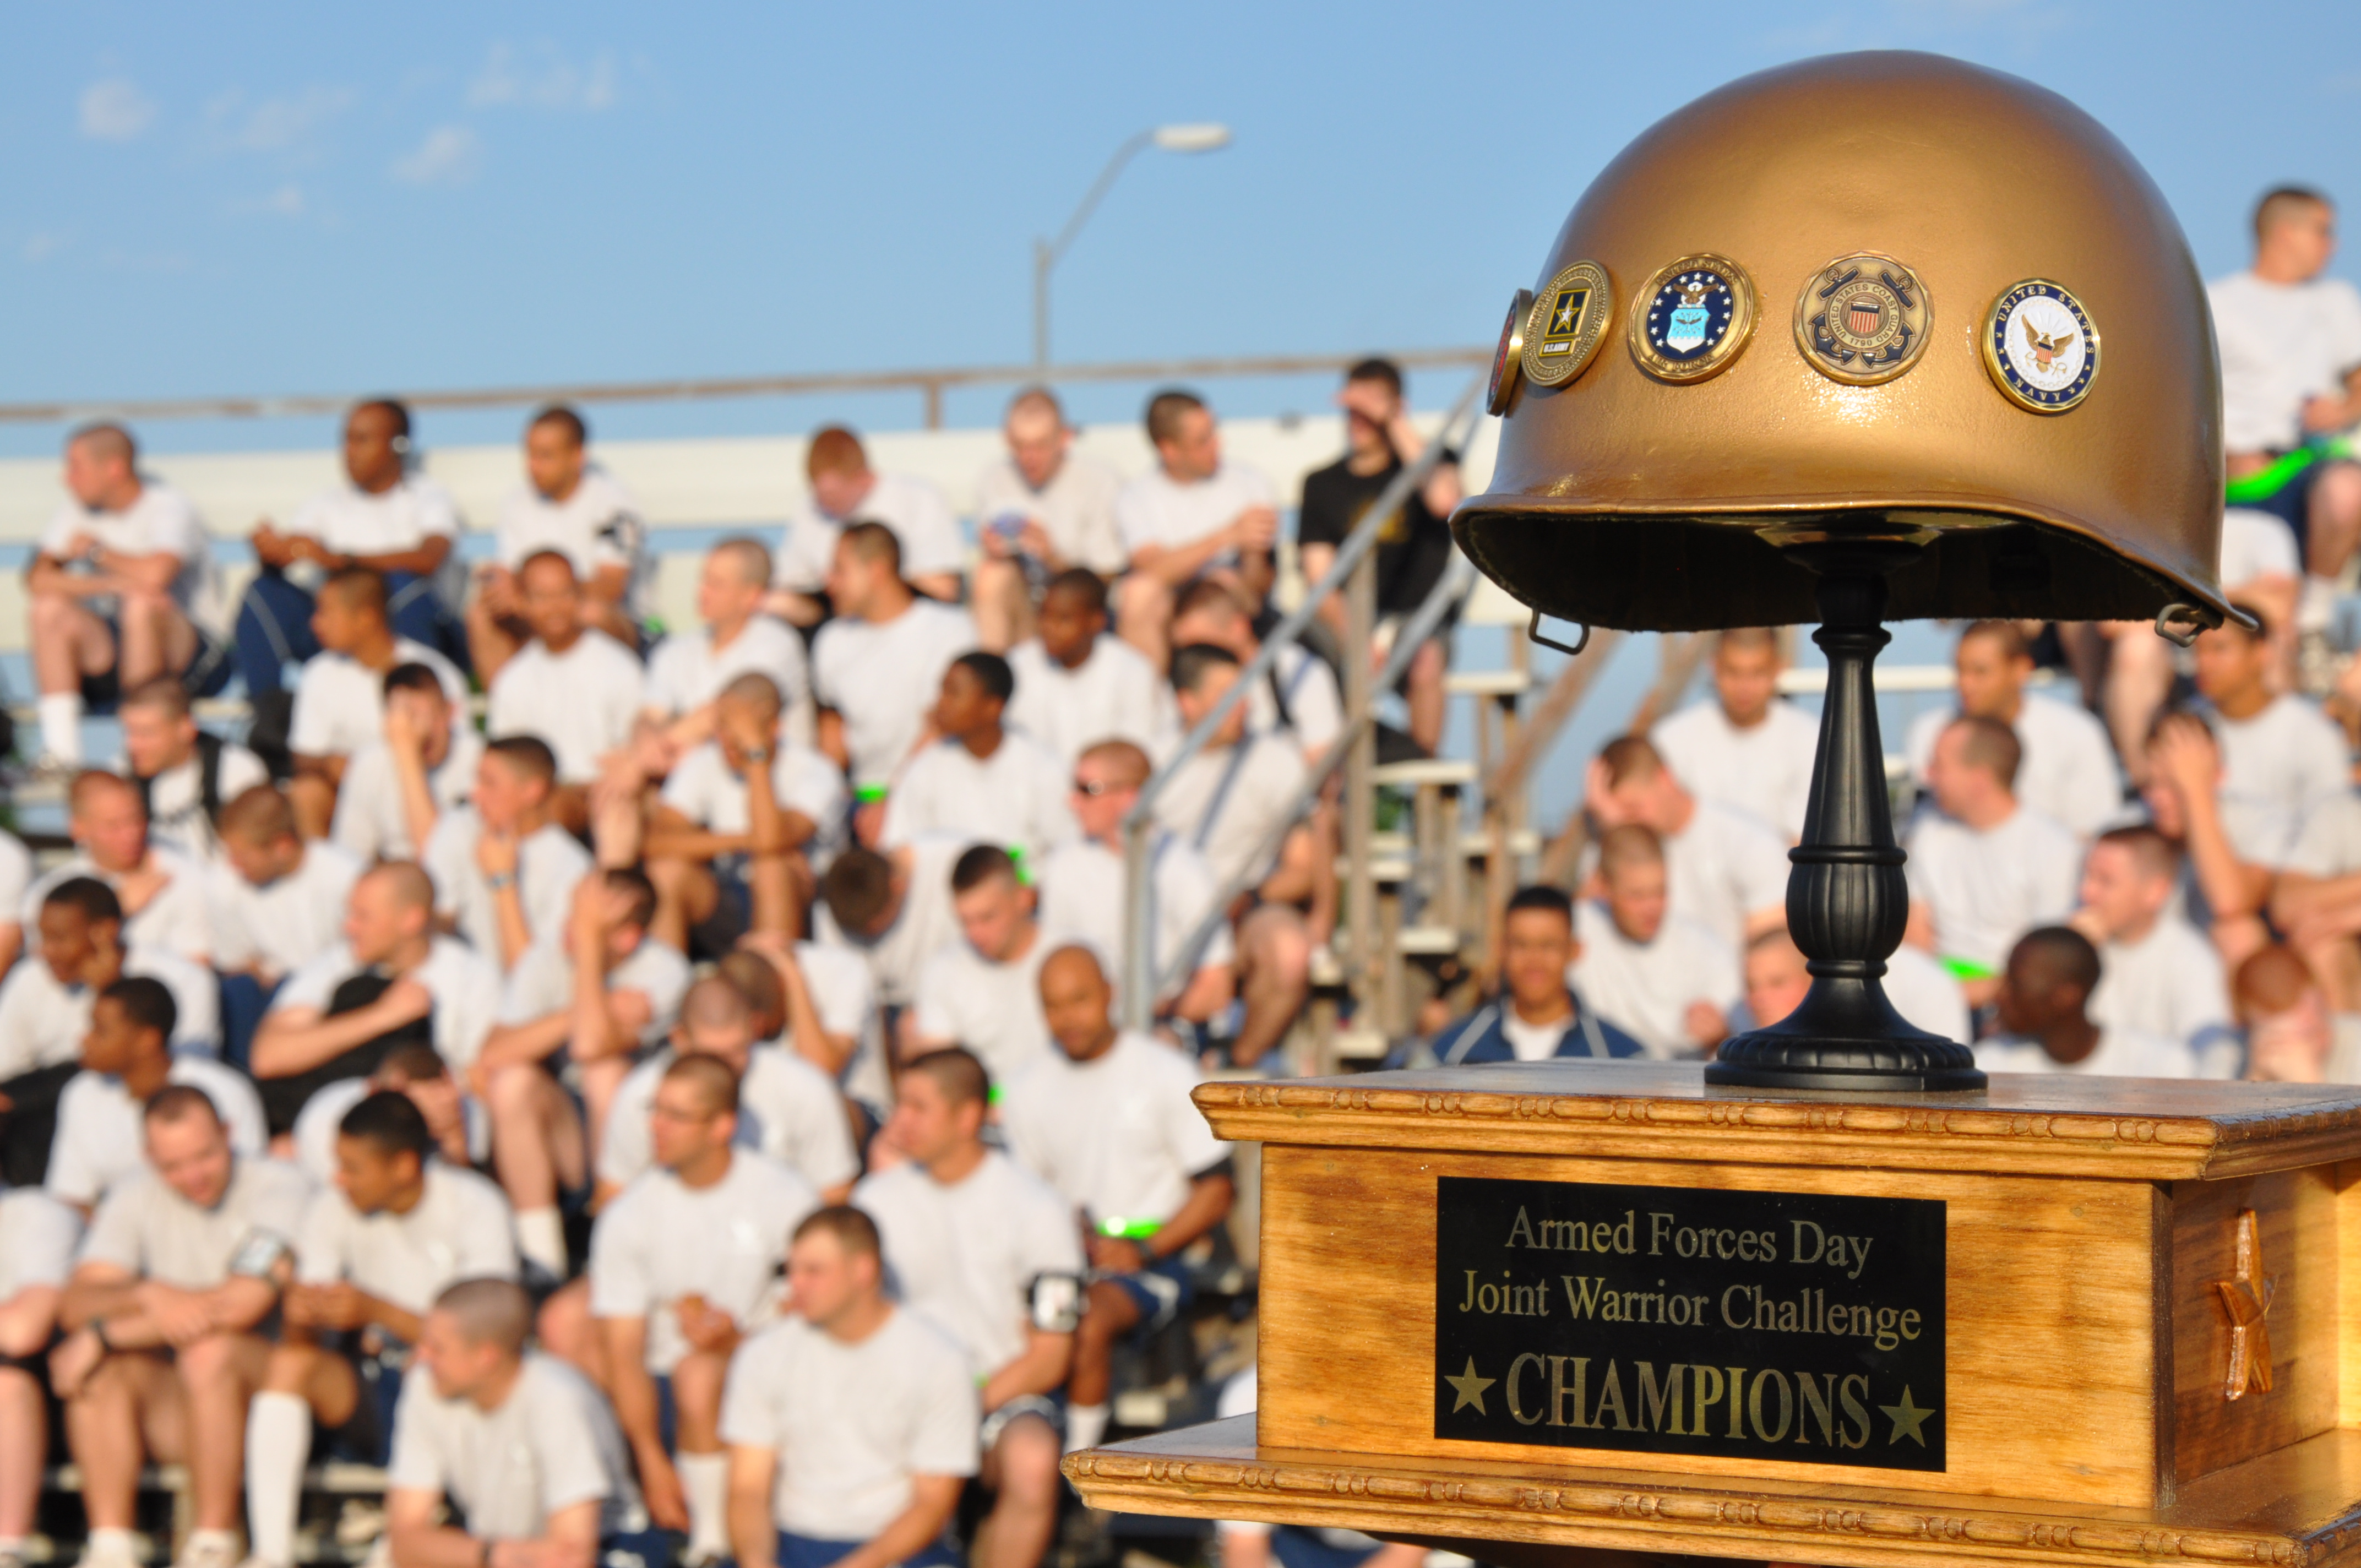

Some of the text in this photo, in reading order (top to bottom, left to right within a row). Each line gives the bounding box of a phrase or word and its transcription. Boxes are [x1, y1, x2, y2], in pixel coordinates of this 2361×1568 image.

[1656, 260, 1739, 286] UNITED STATES
[1831, 284, 1898, 343] UNITED STATES COAST GUARD
[1849, 337, 1873, 347] 1790
[1998, 285, 2095, 354] UNITED STATES
[1648, 354, 1715, 371] AIR FORCE
[2014, 377, 2061, 402] NAVY
[1505, 1205, 1873, 1280] Armed Forces Day
[1459, 1270, 1921, 1352] Joint Warrior Challenge
[1506, 1353, 1871, 1450] CHAMPIONS
